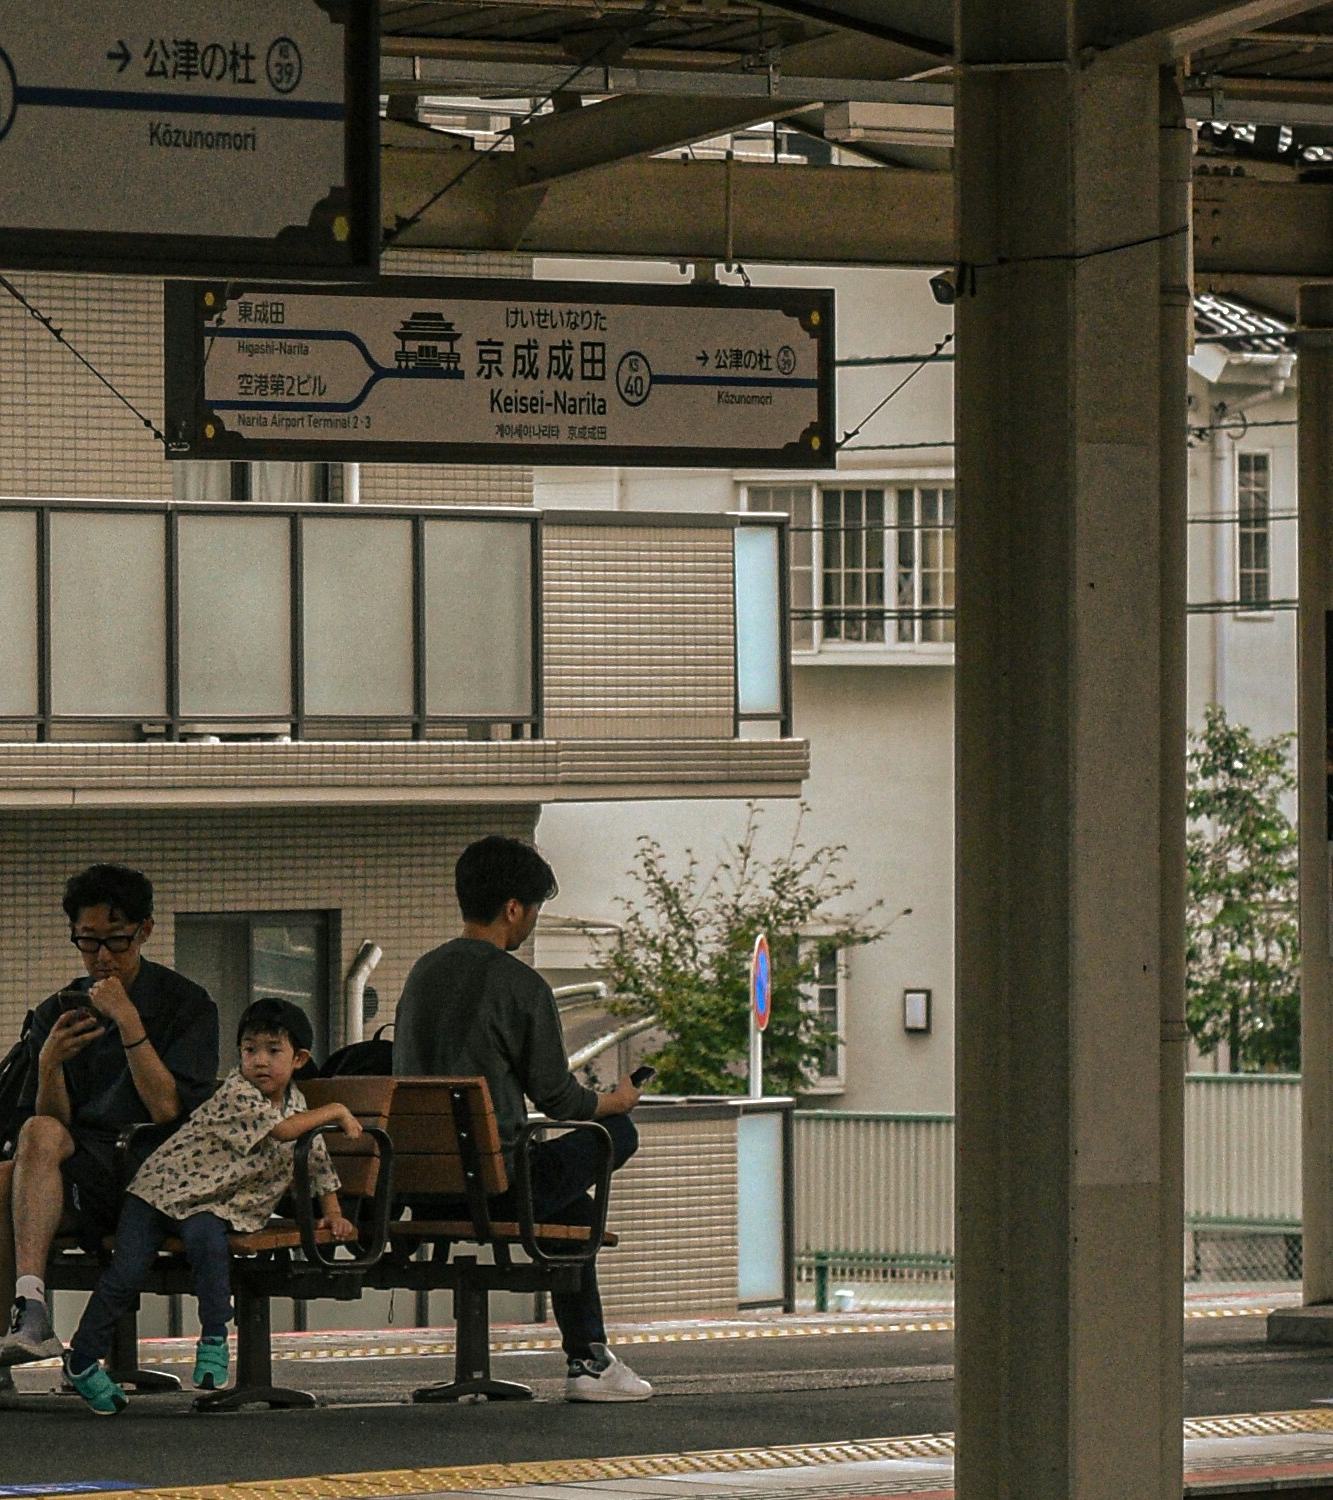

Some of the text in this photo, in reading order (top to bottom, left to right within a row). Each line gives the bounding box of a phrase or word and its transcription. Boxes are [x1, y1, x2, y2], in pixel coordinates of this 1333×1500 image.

[143, 38, 257, 85] 公津の杜
[273, 61, 295, 84] 39
[149, 121, 257, 151] Kōzunomori
[237, 301, 285, 324] 東成田
[505, 307, 607, 332] けいせいなりた
[237, 340, 310, 358] Higashi-Narita
[475, 337, 606, 381] 京成成田
[714, 347, 773, 371] 公津の杜
[237, 372, 327, 397] 空港第2ビル
[624, 375, 644, 398] 40
[489, 388, 607, 416] Keisei-Narita
[237, 413, 268, 428] Narita
[271, 414, 305, 430] Airport
[308, 414, 351, 429] Terminal
